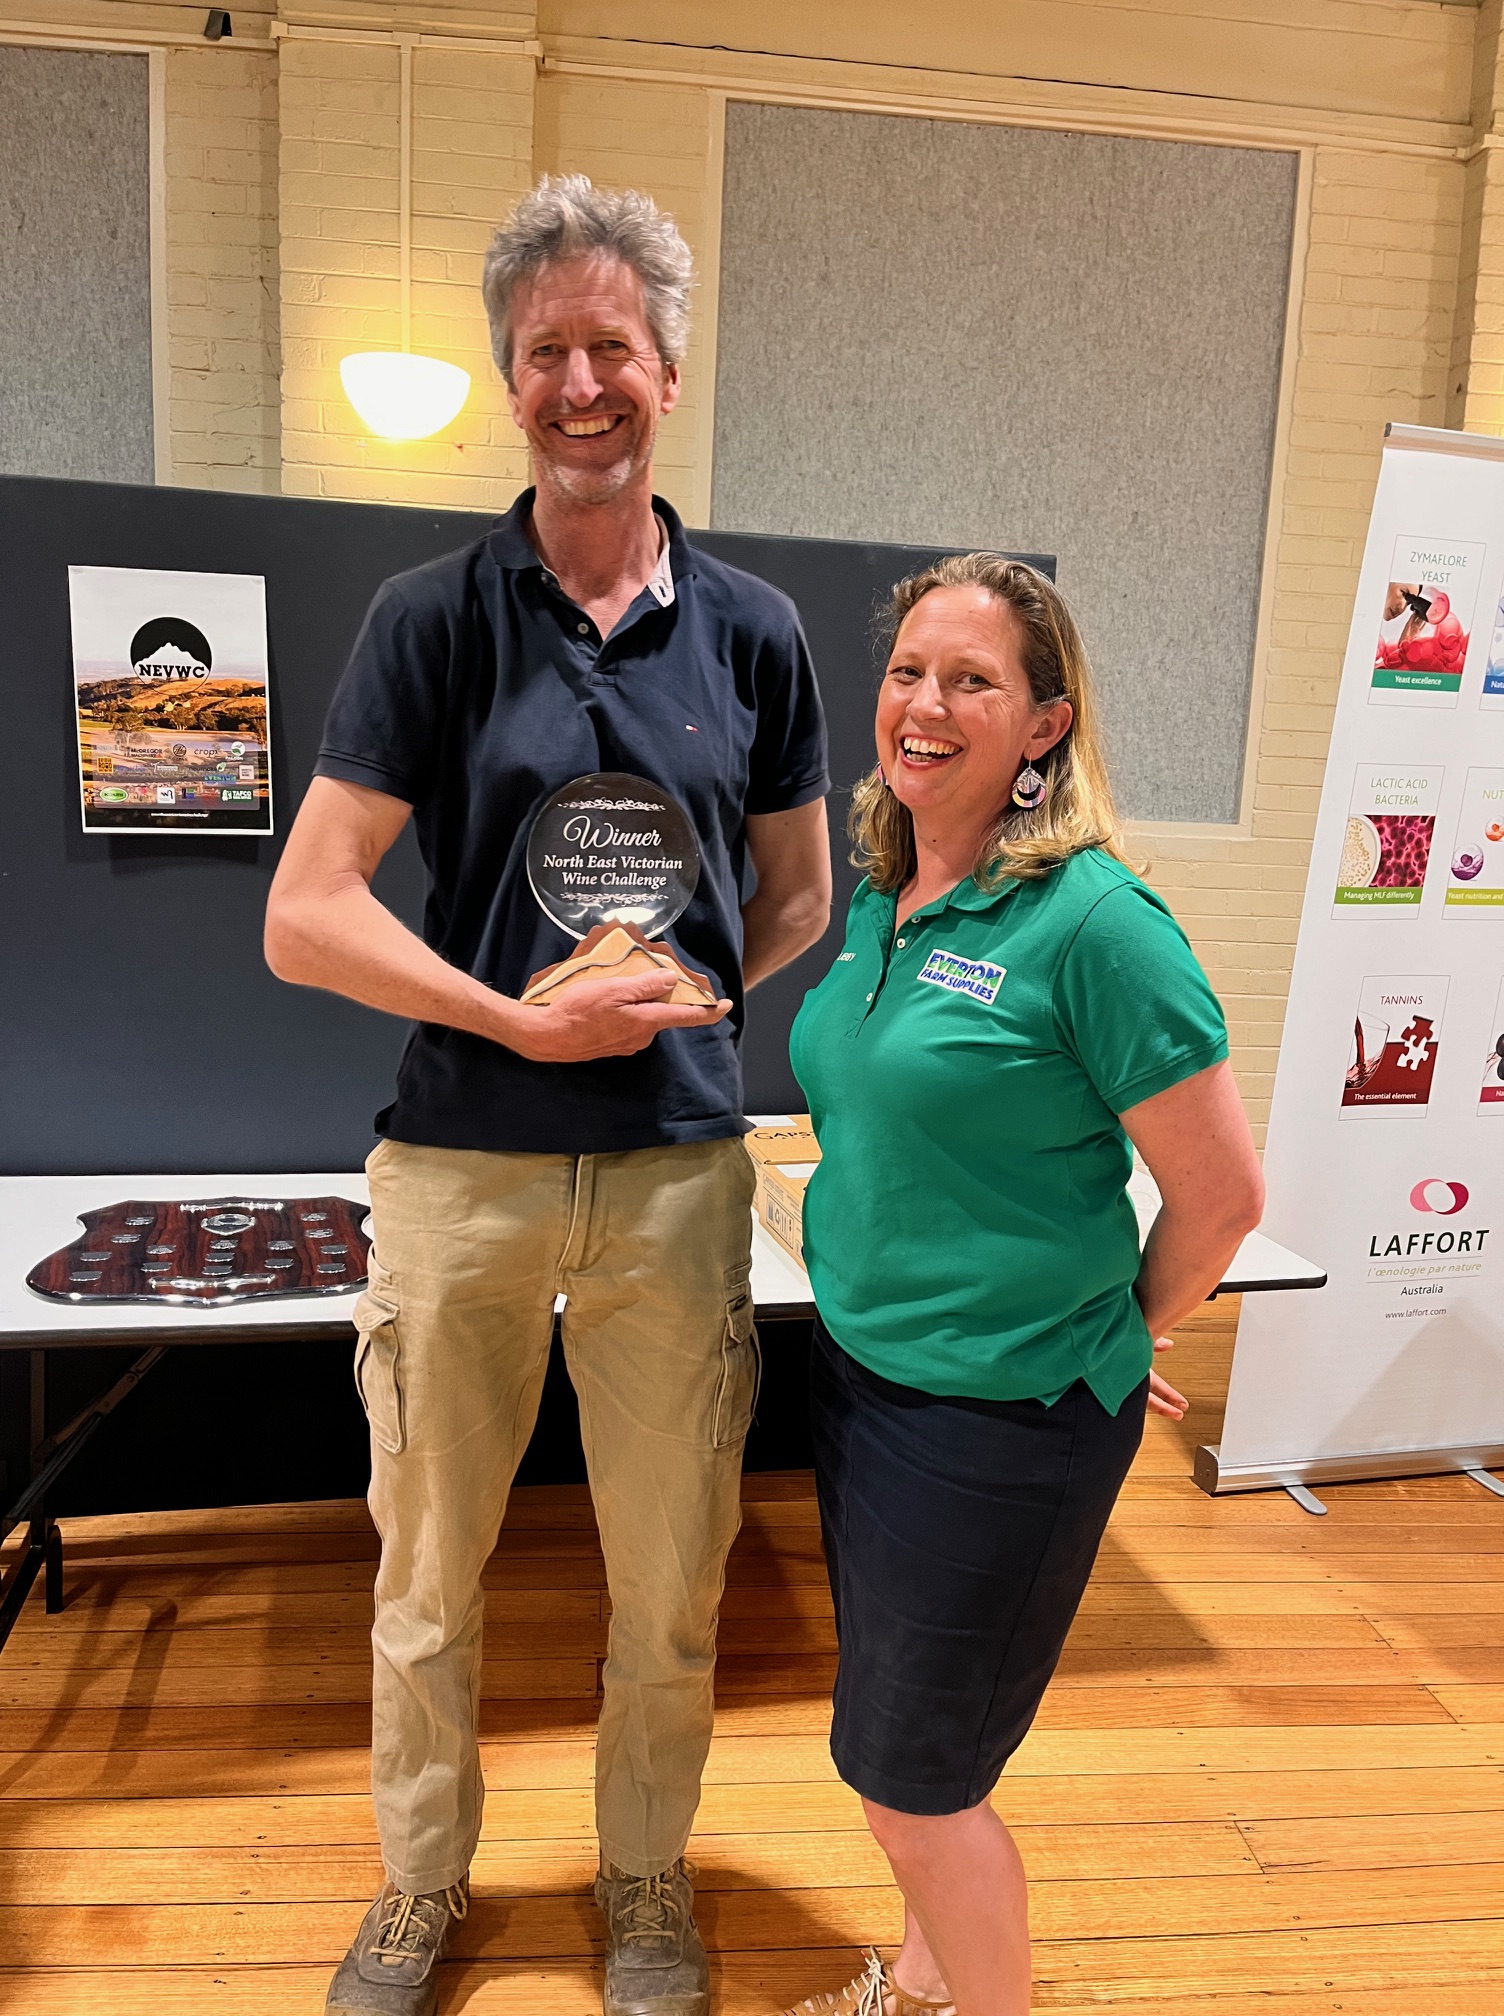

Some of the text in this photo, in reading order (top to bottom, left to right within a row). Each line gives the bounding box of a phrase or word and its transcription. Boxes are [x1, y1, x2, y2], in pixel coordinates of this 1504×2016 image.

[1410, 551, 1468, 567] ZYMAFLORE
[1421, 570, 1451, 584] YEAST
[138, 664, 206, 679] NEVWC
[1394, 674, 1442, 686] Yeast excellence
[1370, 778, 1428, 789] LACTIC ACID
[1374, 794, 1419, 805] BACTERIA
[563, 815, 662, 850] Winner
[543, 854, 683, 870] North East Victorian
[562, 872, 667, 890] Wine Challenge
[1344, 892, 1373, 900] Managing
[1386, 892, 1414, 900] differently
[927, 952, 1002, 989] EVERTON
[920, 968, 994, 1000] FARM SUPPLIES
[1380, 996, 1424, 1005] TANNINS
[1369, 1229, 1490, 1257] LAFFORT
[1427, 1265, 1446, 1276] par
[1448, 1262, 1482, 1272] nature
[1400, 1284, 1444, 1296] Australia
[1385, 1308, 1447, 1319] www.laffort.com
